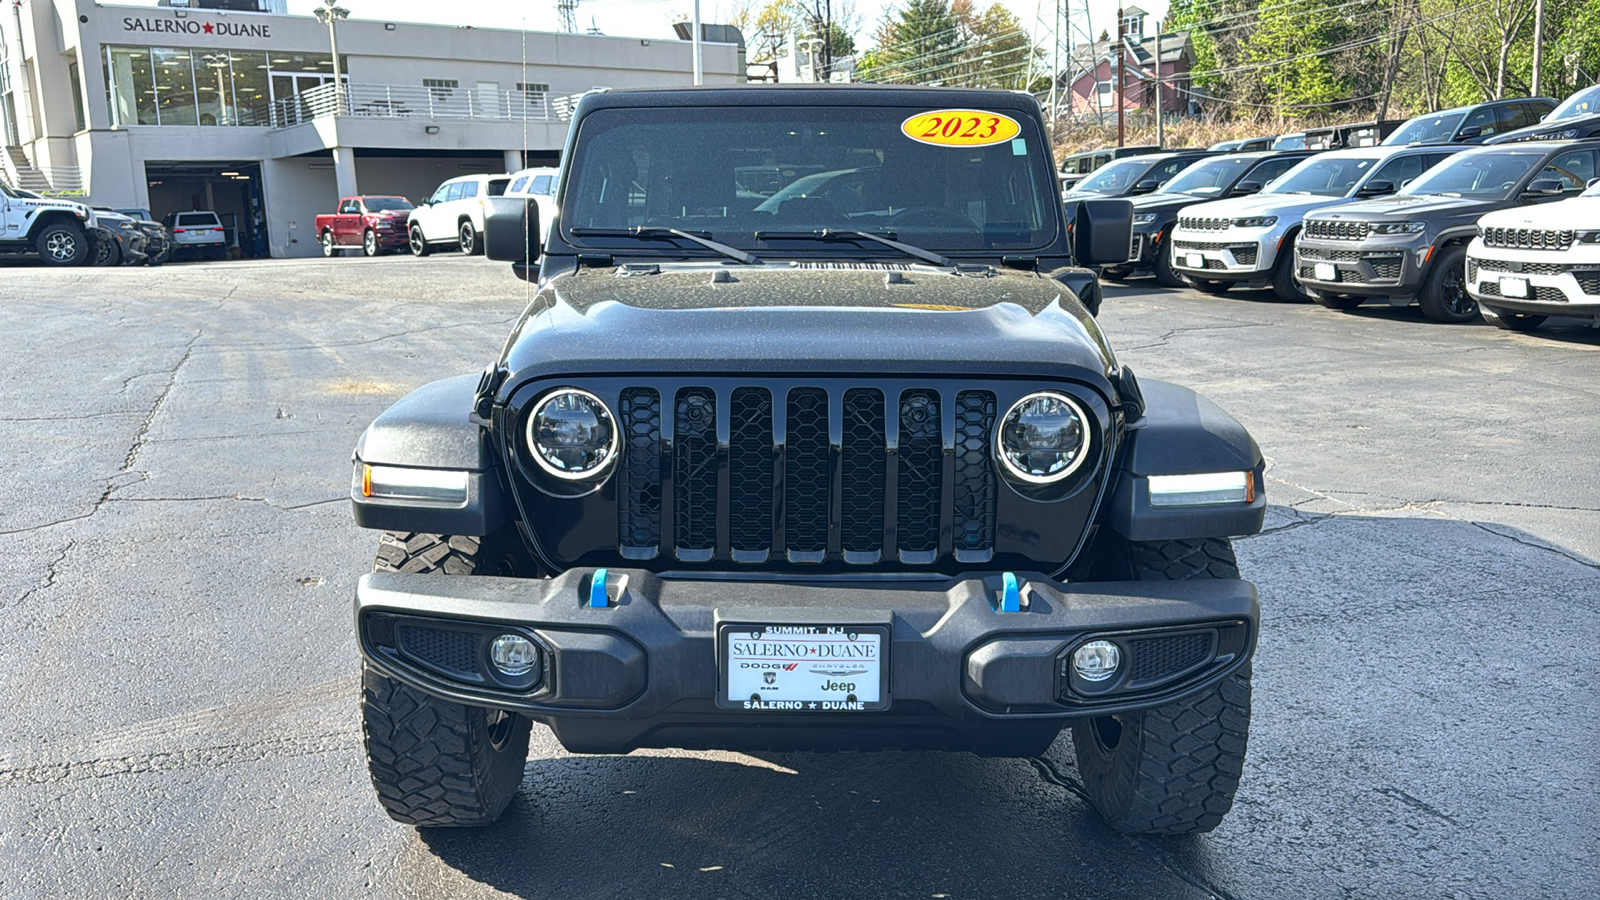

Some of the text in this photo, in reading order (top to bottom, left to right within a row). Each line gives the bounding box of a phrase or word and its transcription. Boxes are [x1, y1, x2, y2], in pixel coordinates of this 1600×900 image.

[123, 17, 271, 37] SALERNO DUANE
[920, 116, 1001, 138] 2023
[826, 626, 845, 635] NJ
[733, 643, 876, 658] SALERNO DUANE
[740, 662, 792, 670] DODGE
[820, 679, 856, 694] Jeep
[743, 700, 865, 710] SALERNO DUANE
